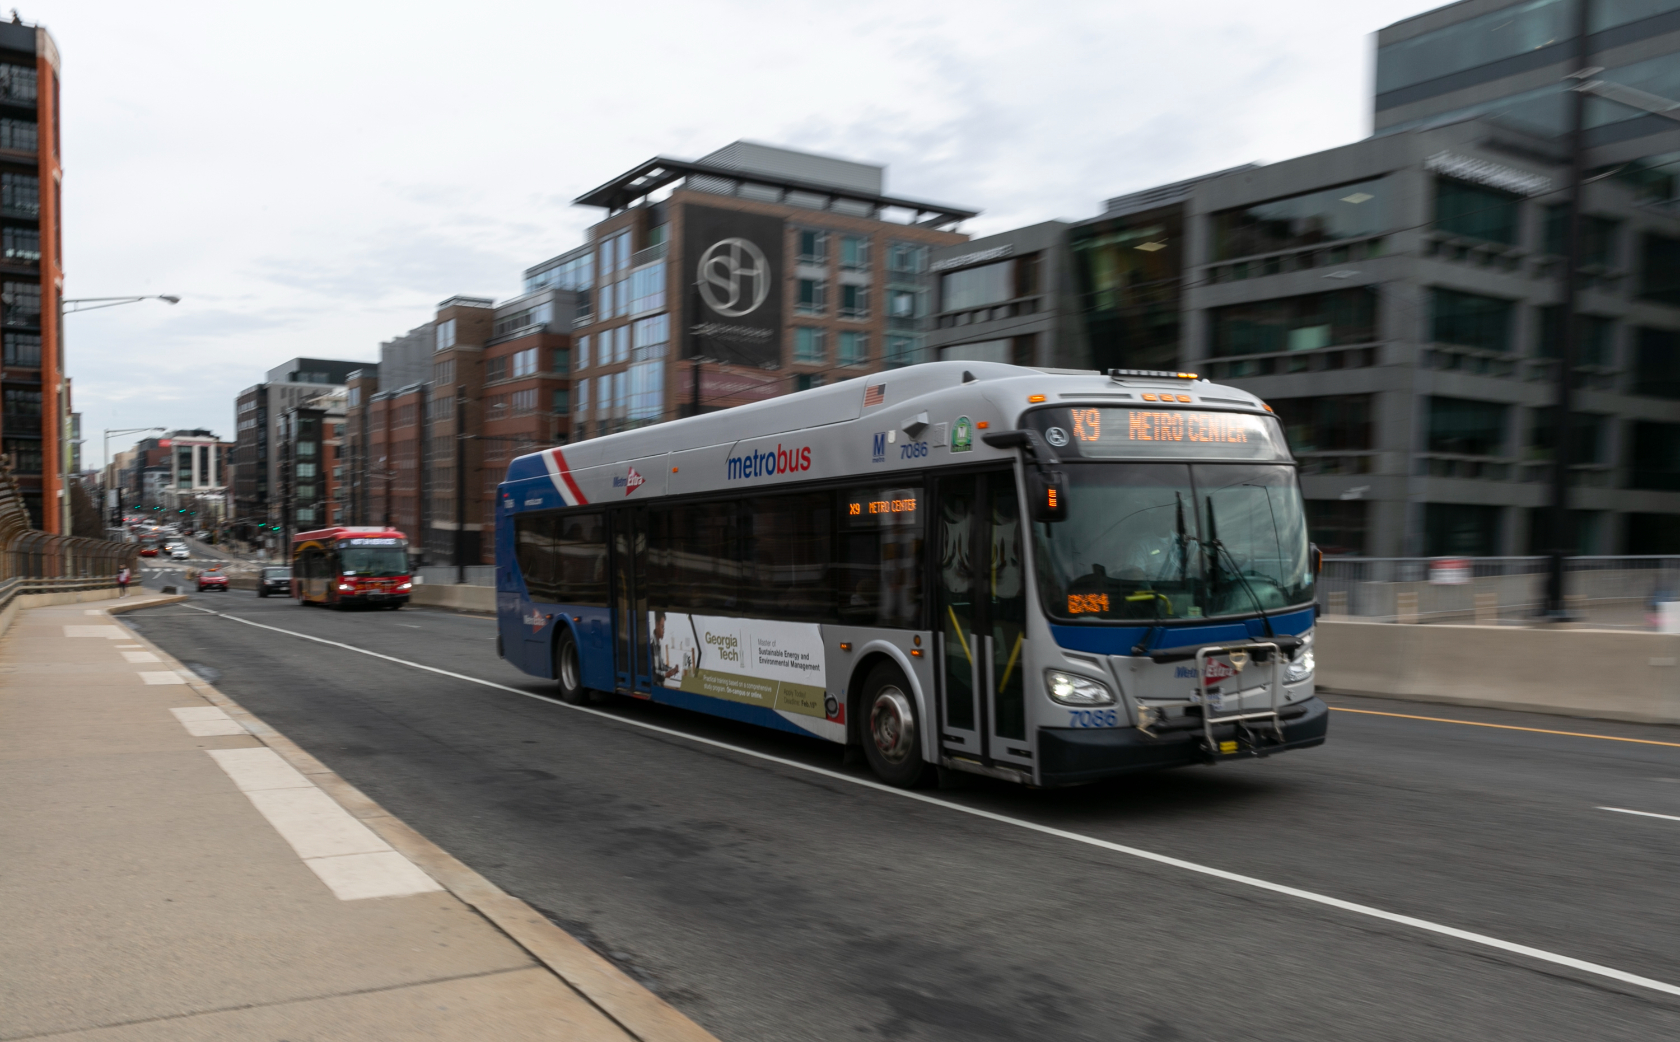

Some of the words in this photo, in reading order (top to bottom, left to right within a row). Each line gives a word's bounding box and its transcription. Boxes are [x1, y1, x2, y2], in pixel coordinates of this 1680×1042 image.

[1071, 408, 1101, 441] X9
[1129, 411, 1184, 441] METRO
[1188, 413, 1247, 443] CENTER
[873, 433, 885, 456] M
[900, 442, 928, 459] 7086
[728, 443, 811, 480] metrobus
[849, 503, 860, 515] X9
[868, 500, 890, 514] METRO
[891, 498, 916, 512] CENTER
[705, 631, 738, 649] Georgia
[757, 638, 771, 647] Master
[772, 639, 776, 647] of
[718, 647, 739, 662] Tech
[758, 647, 783, 657] Sustainable
[784, 650, 799, 661] Energy
[801, 652, 810, 661] and
[759, 656, 789, 667] Environmental
[717, 677, 728, 686] training
[728, 679, 738, 687] based
[747, 683, 772, 692] comprehensive
[1067, 709, 1118, 728] 7086
